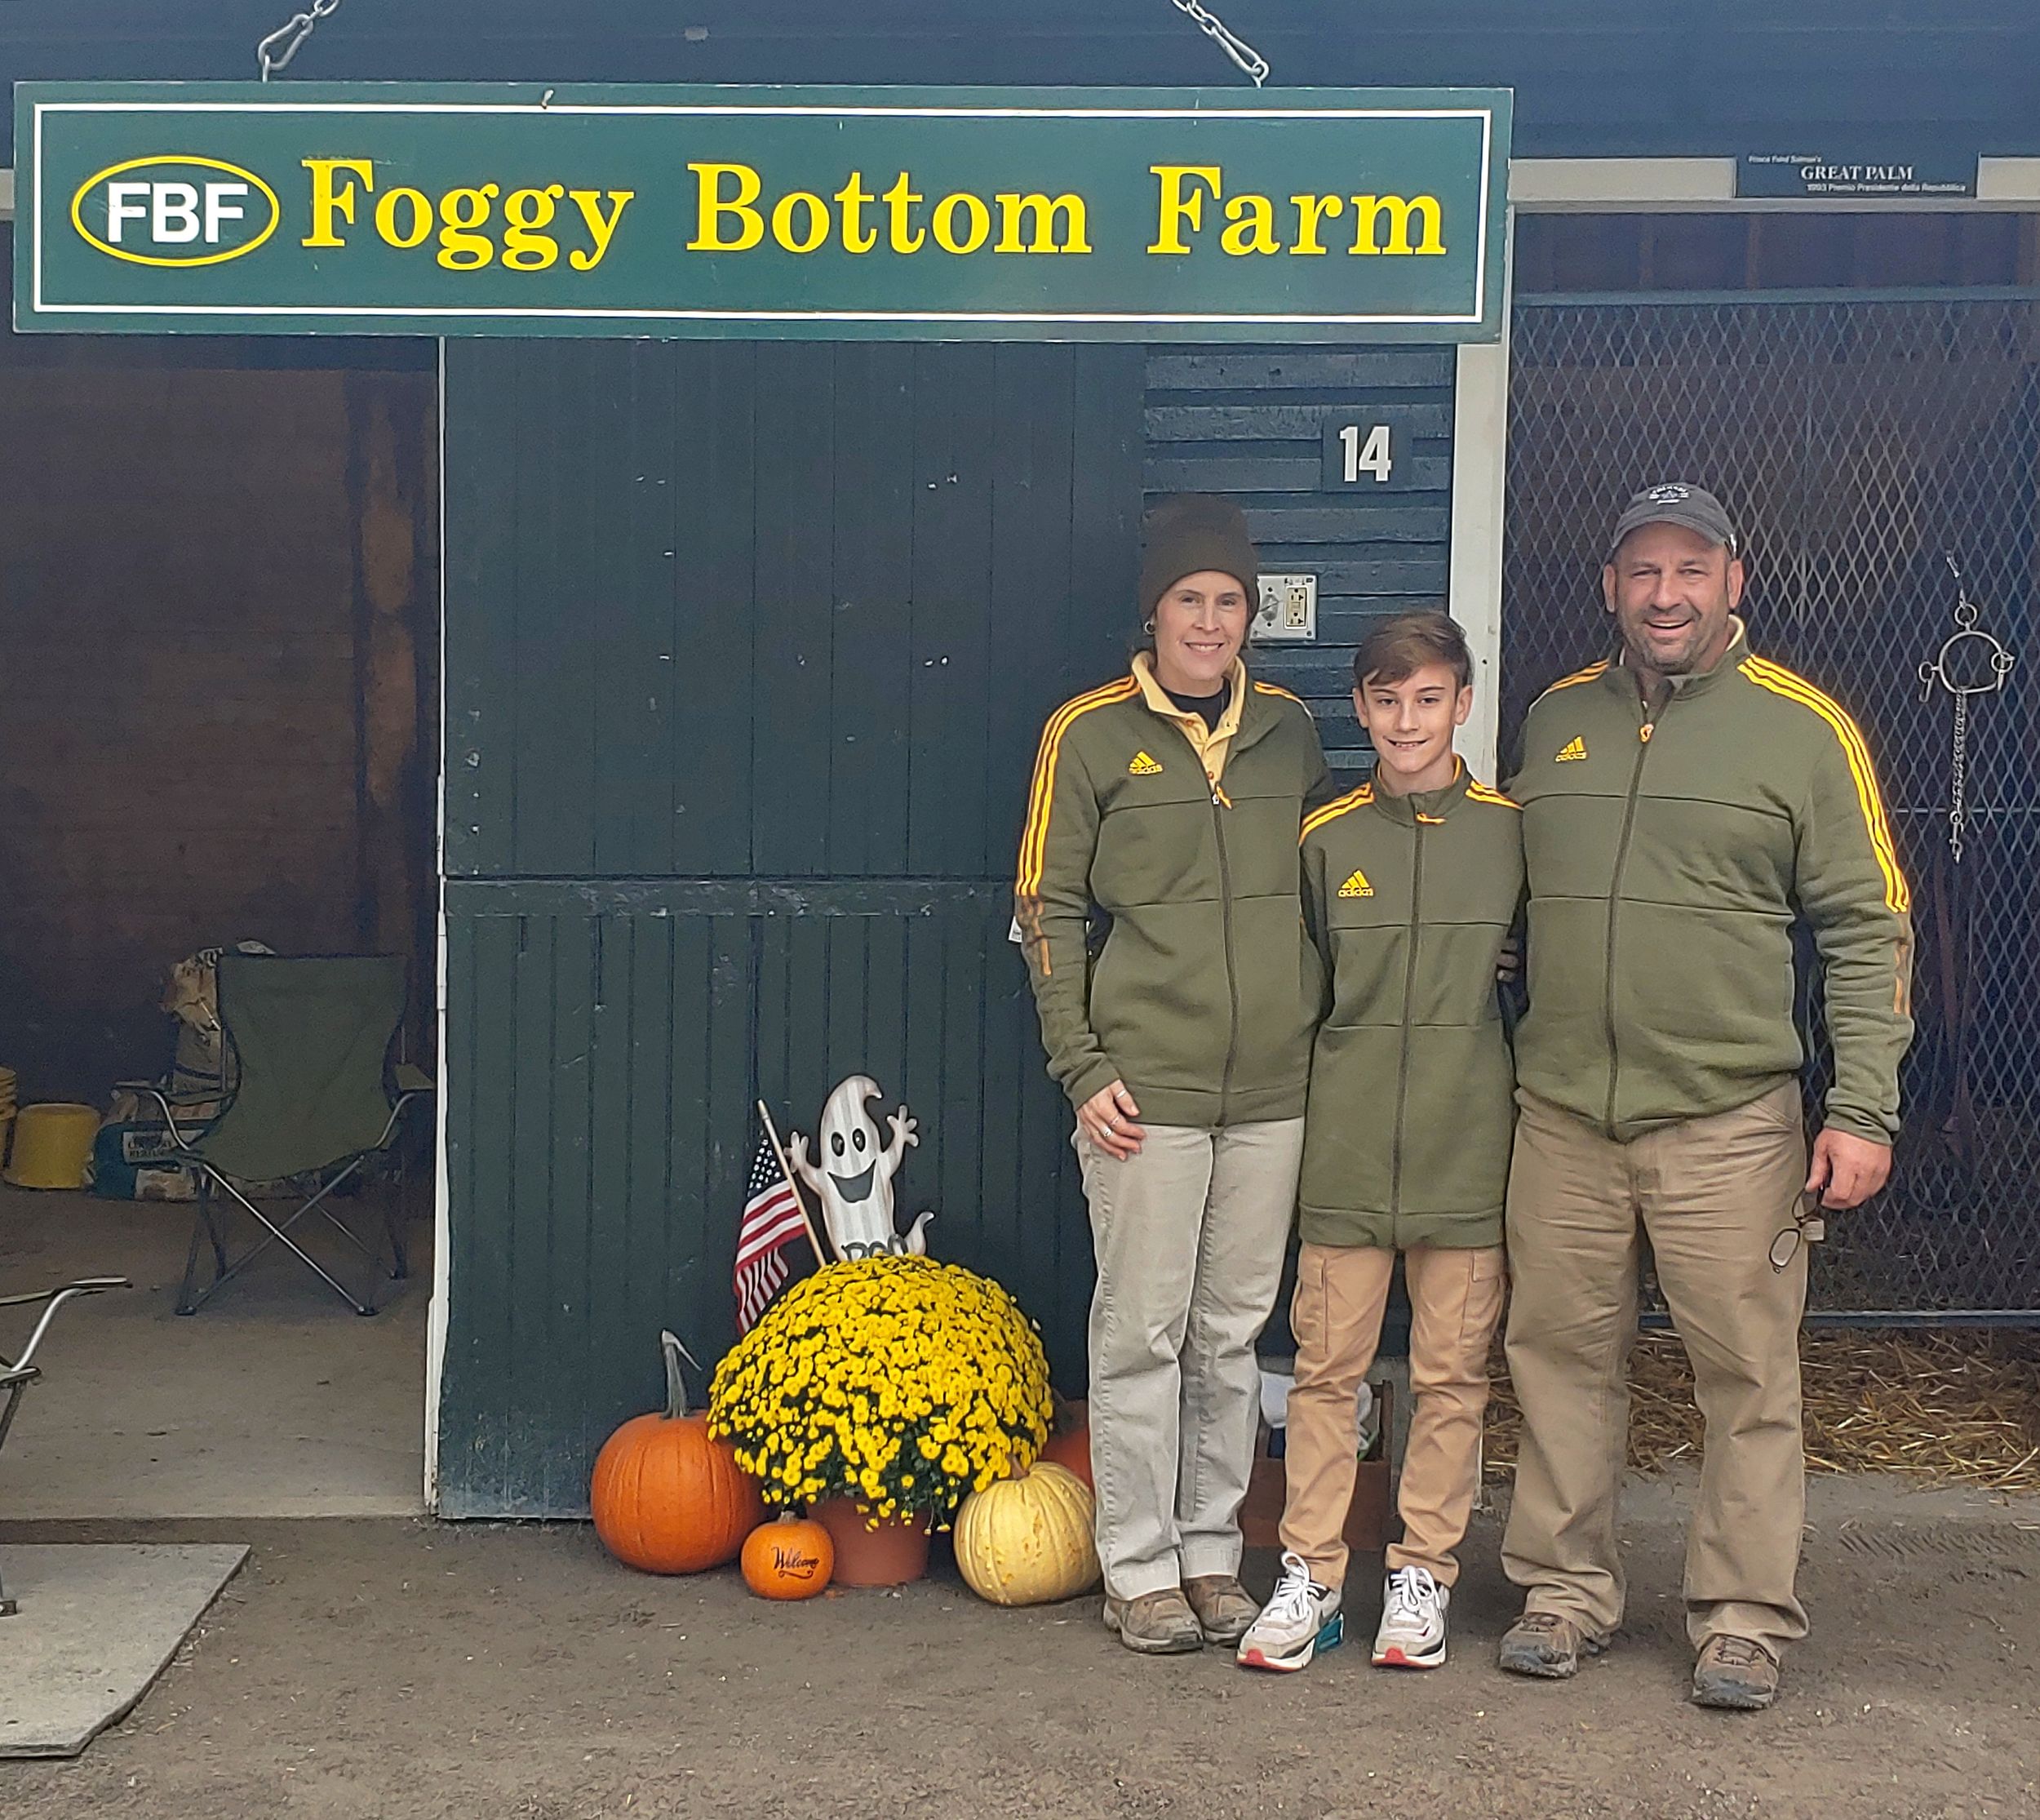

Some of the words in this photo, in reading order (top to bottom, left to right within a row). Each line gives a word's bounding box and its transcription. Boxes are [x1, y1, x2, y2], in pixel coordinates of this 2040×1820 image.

[1800, 166, 1861, 180] GREAT
[1865, 166, 1913, 180] PALM
[108, 182, 248, 242] FBF
[301, 159, 634, 271] Foggy
[686, 163, 1092, 254] Bottom
[1147, 166, 1446, 255] Farm
[1339, 426, 1391, 482] 14
